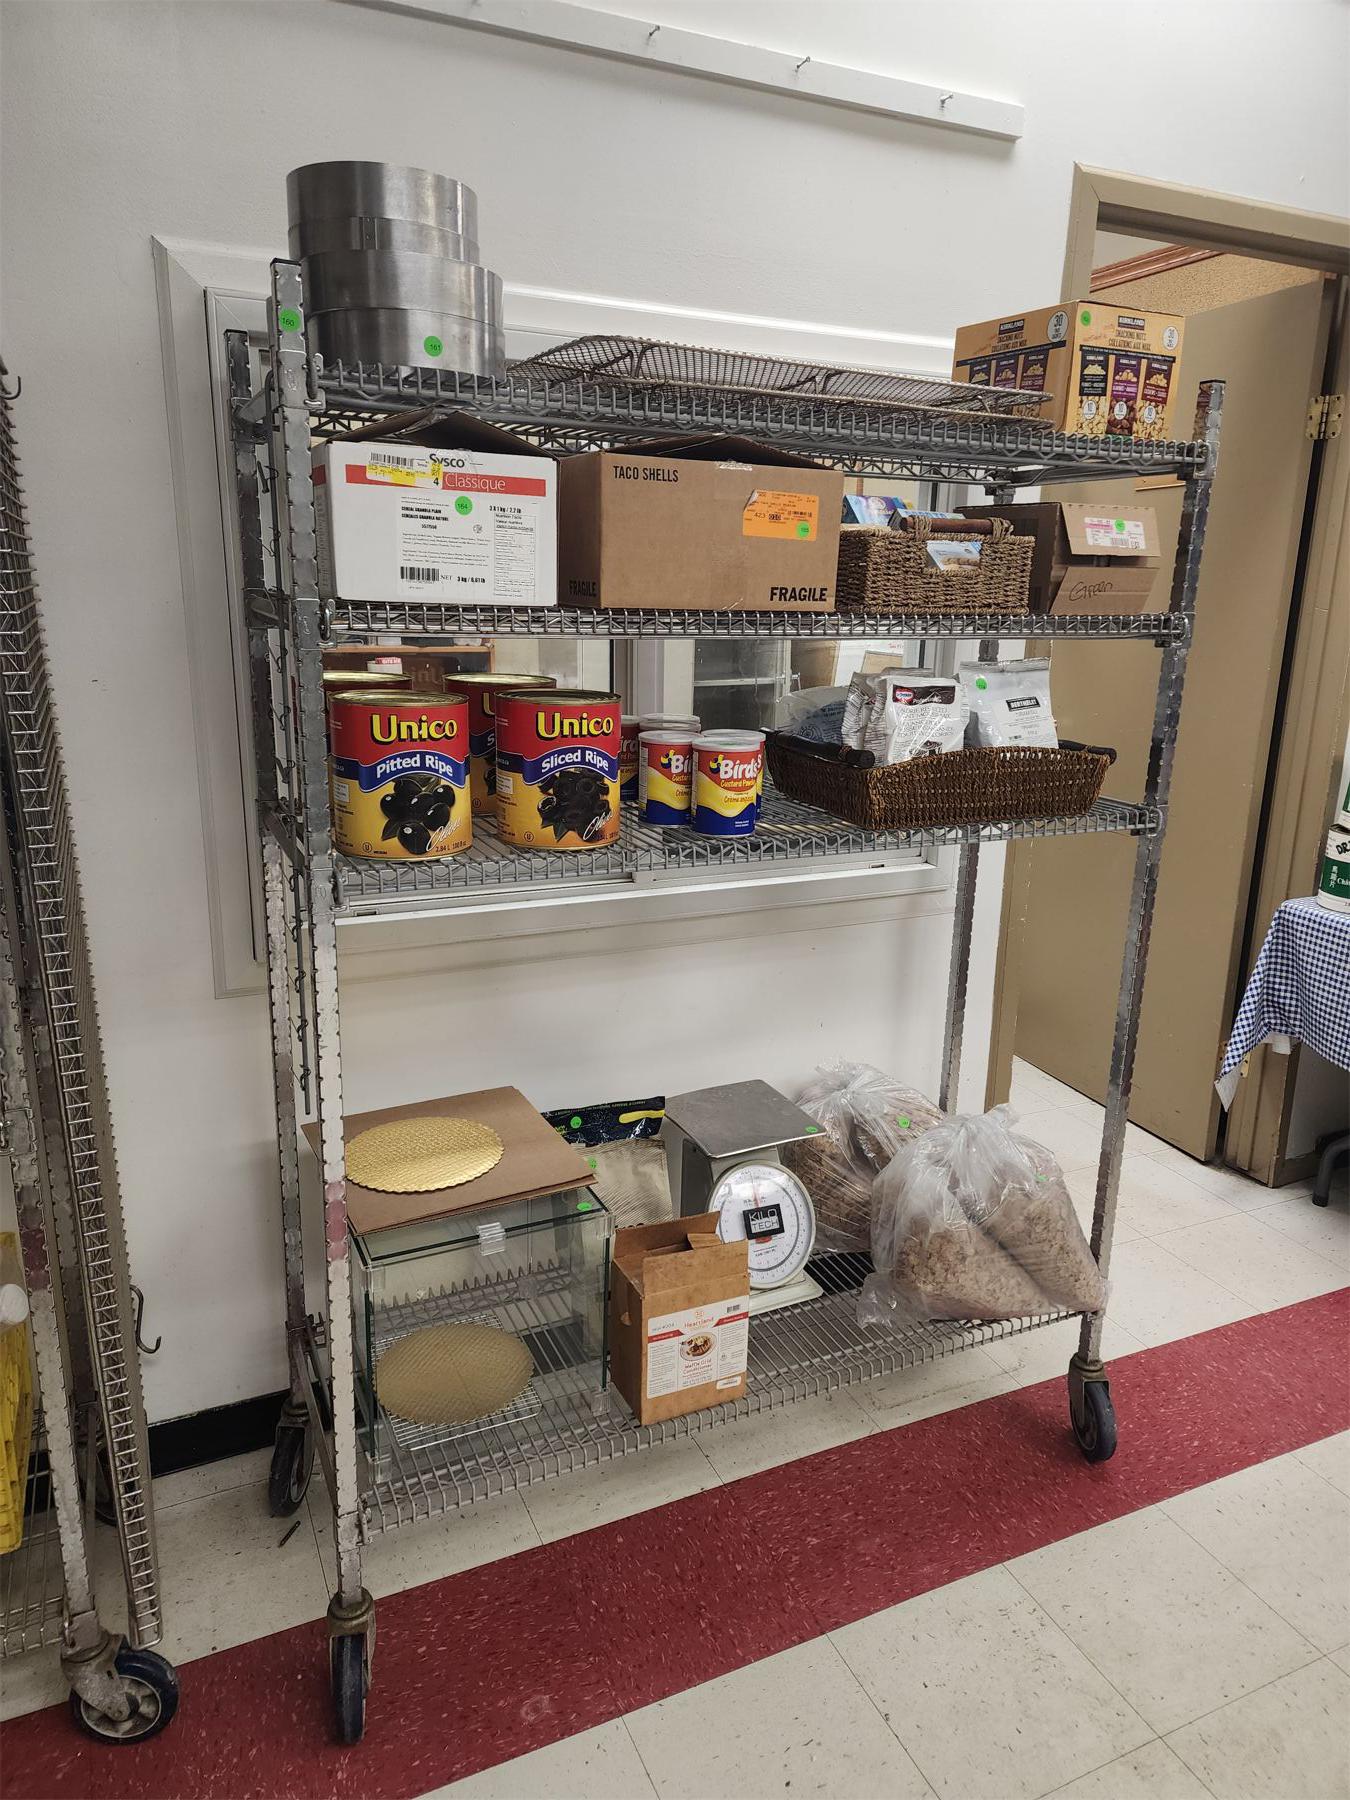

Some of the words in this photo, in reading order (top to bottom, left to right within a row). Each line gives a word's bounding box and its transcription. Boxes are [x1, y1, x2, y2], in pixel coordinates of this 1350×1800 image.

[430, 453, 465, 468] Sysco
[445, 473, 505, 491] Classique
[614, 466, 639, 480] TACO
[643, 468, 679, 482] SHELLS
[569, 580, 596, 598] FRAGILE
[770, 587, 828, 602] FRAGILE
[371, 714, 457, 743] Unico
[536, 712, 613, 739] Unico
[376, 754, 420, 779] Pitted
[425, 756, 453, 777] Ripe
[542, 749, 581, 772] Sliced
[586, 750, 608, 771] Ripe
[749, 1208, 778, 1222] KILO
[752, 1219, 779, 1230] TECH
